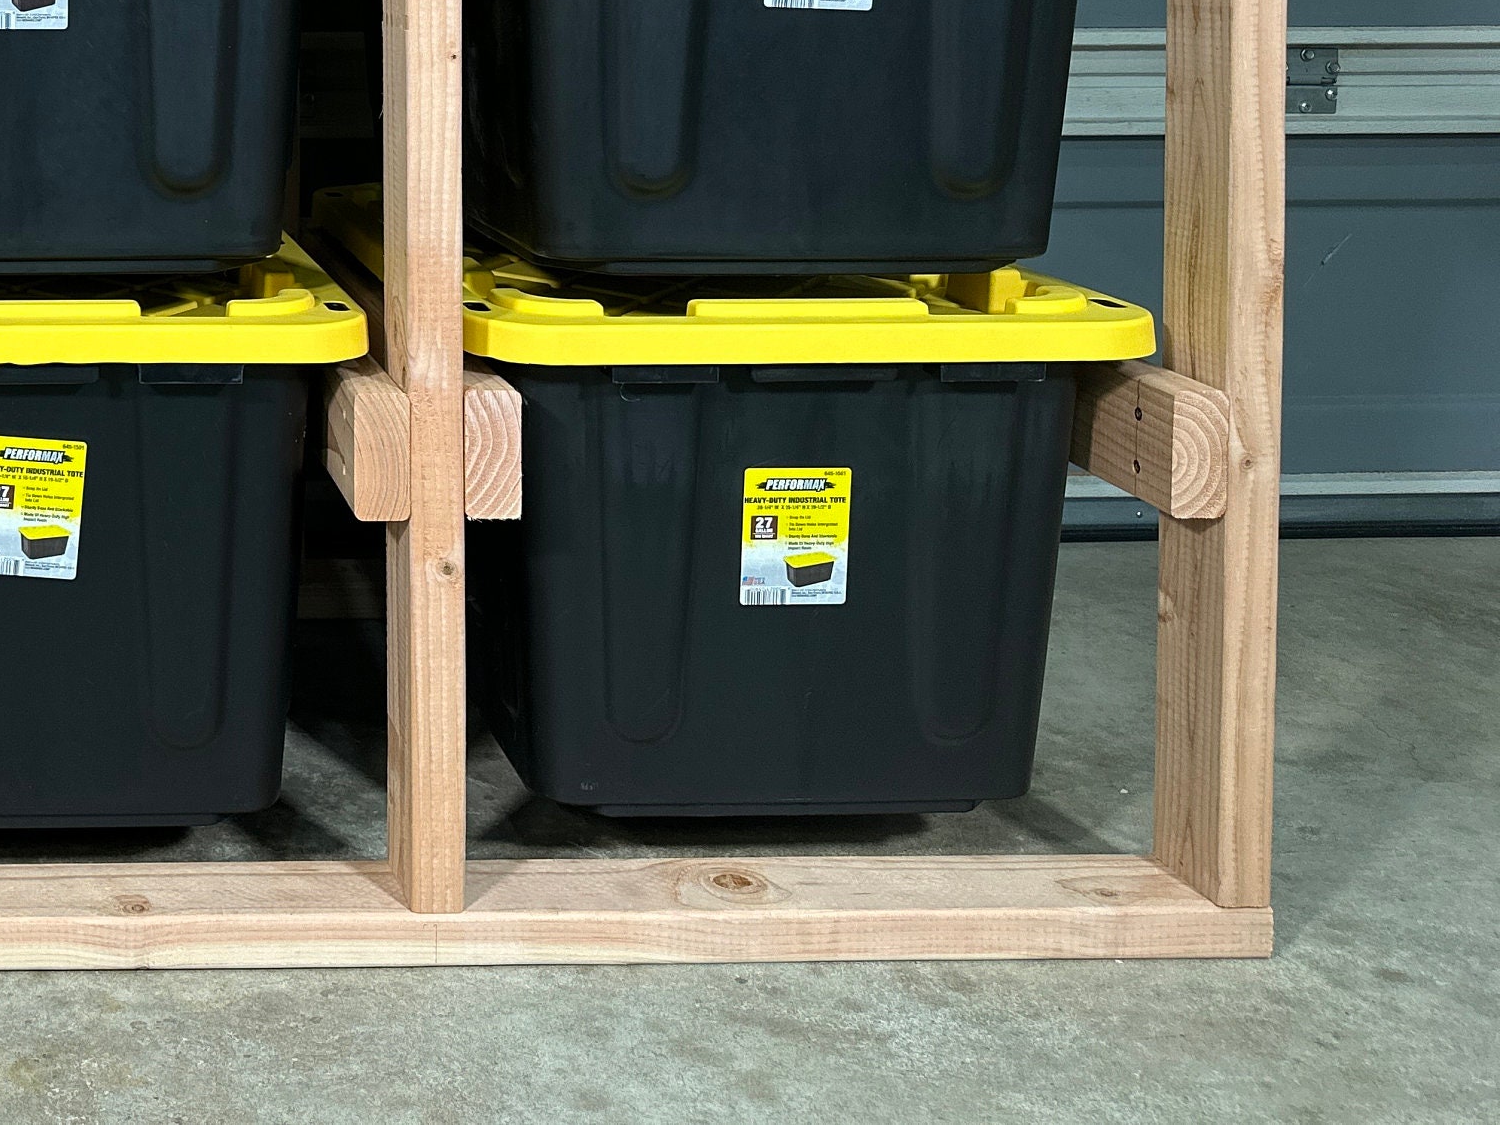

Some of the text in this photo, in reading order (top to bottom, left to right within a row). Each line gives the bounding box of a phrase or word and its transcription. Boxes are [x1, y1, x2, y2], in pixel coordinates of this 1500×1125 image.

[4, 447, 64, 464] PERFORMAX
[26, 468, 65, 476] INDUSTRIAL
[766, 479, 825, 491] PERFORMAX
[756, 517, 773, 528] 27
